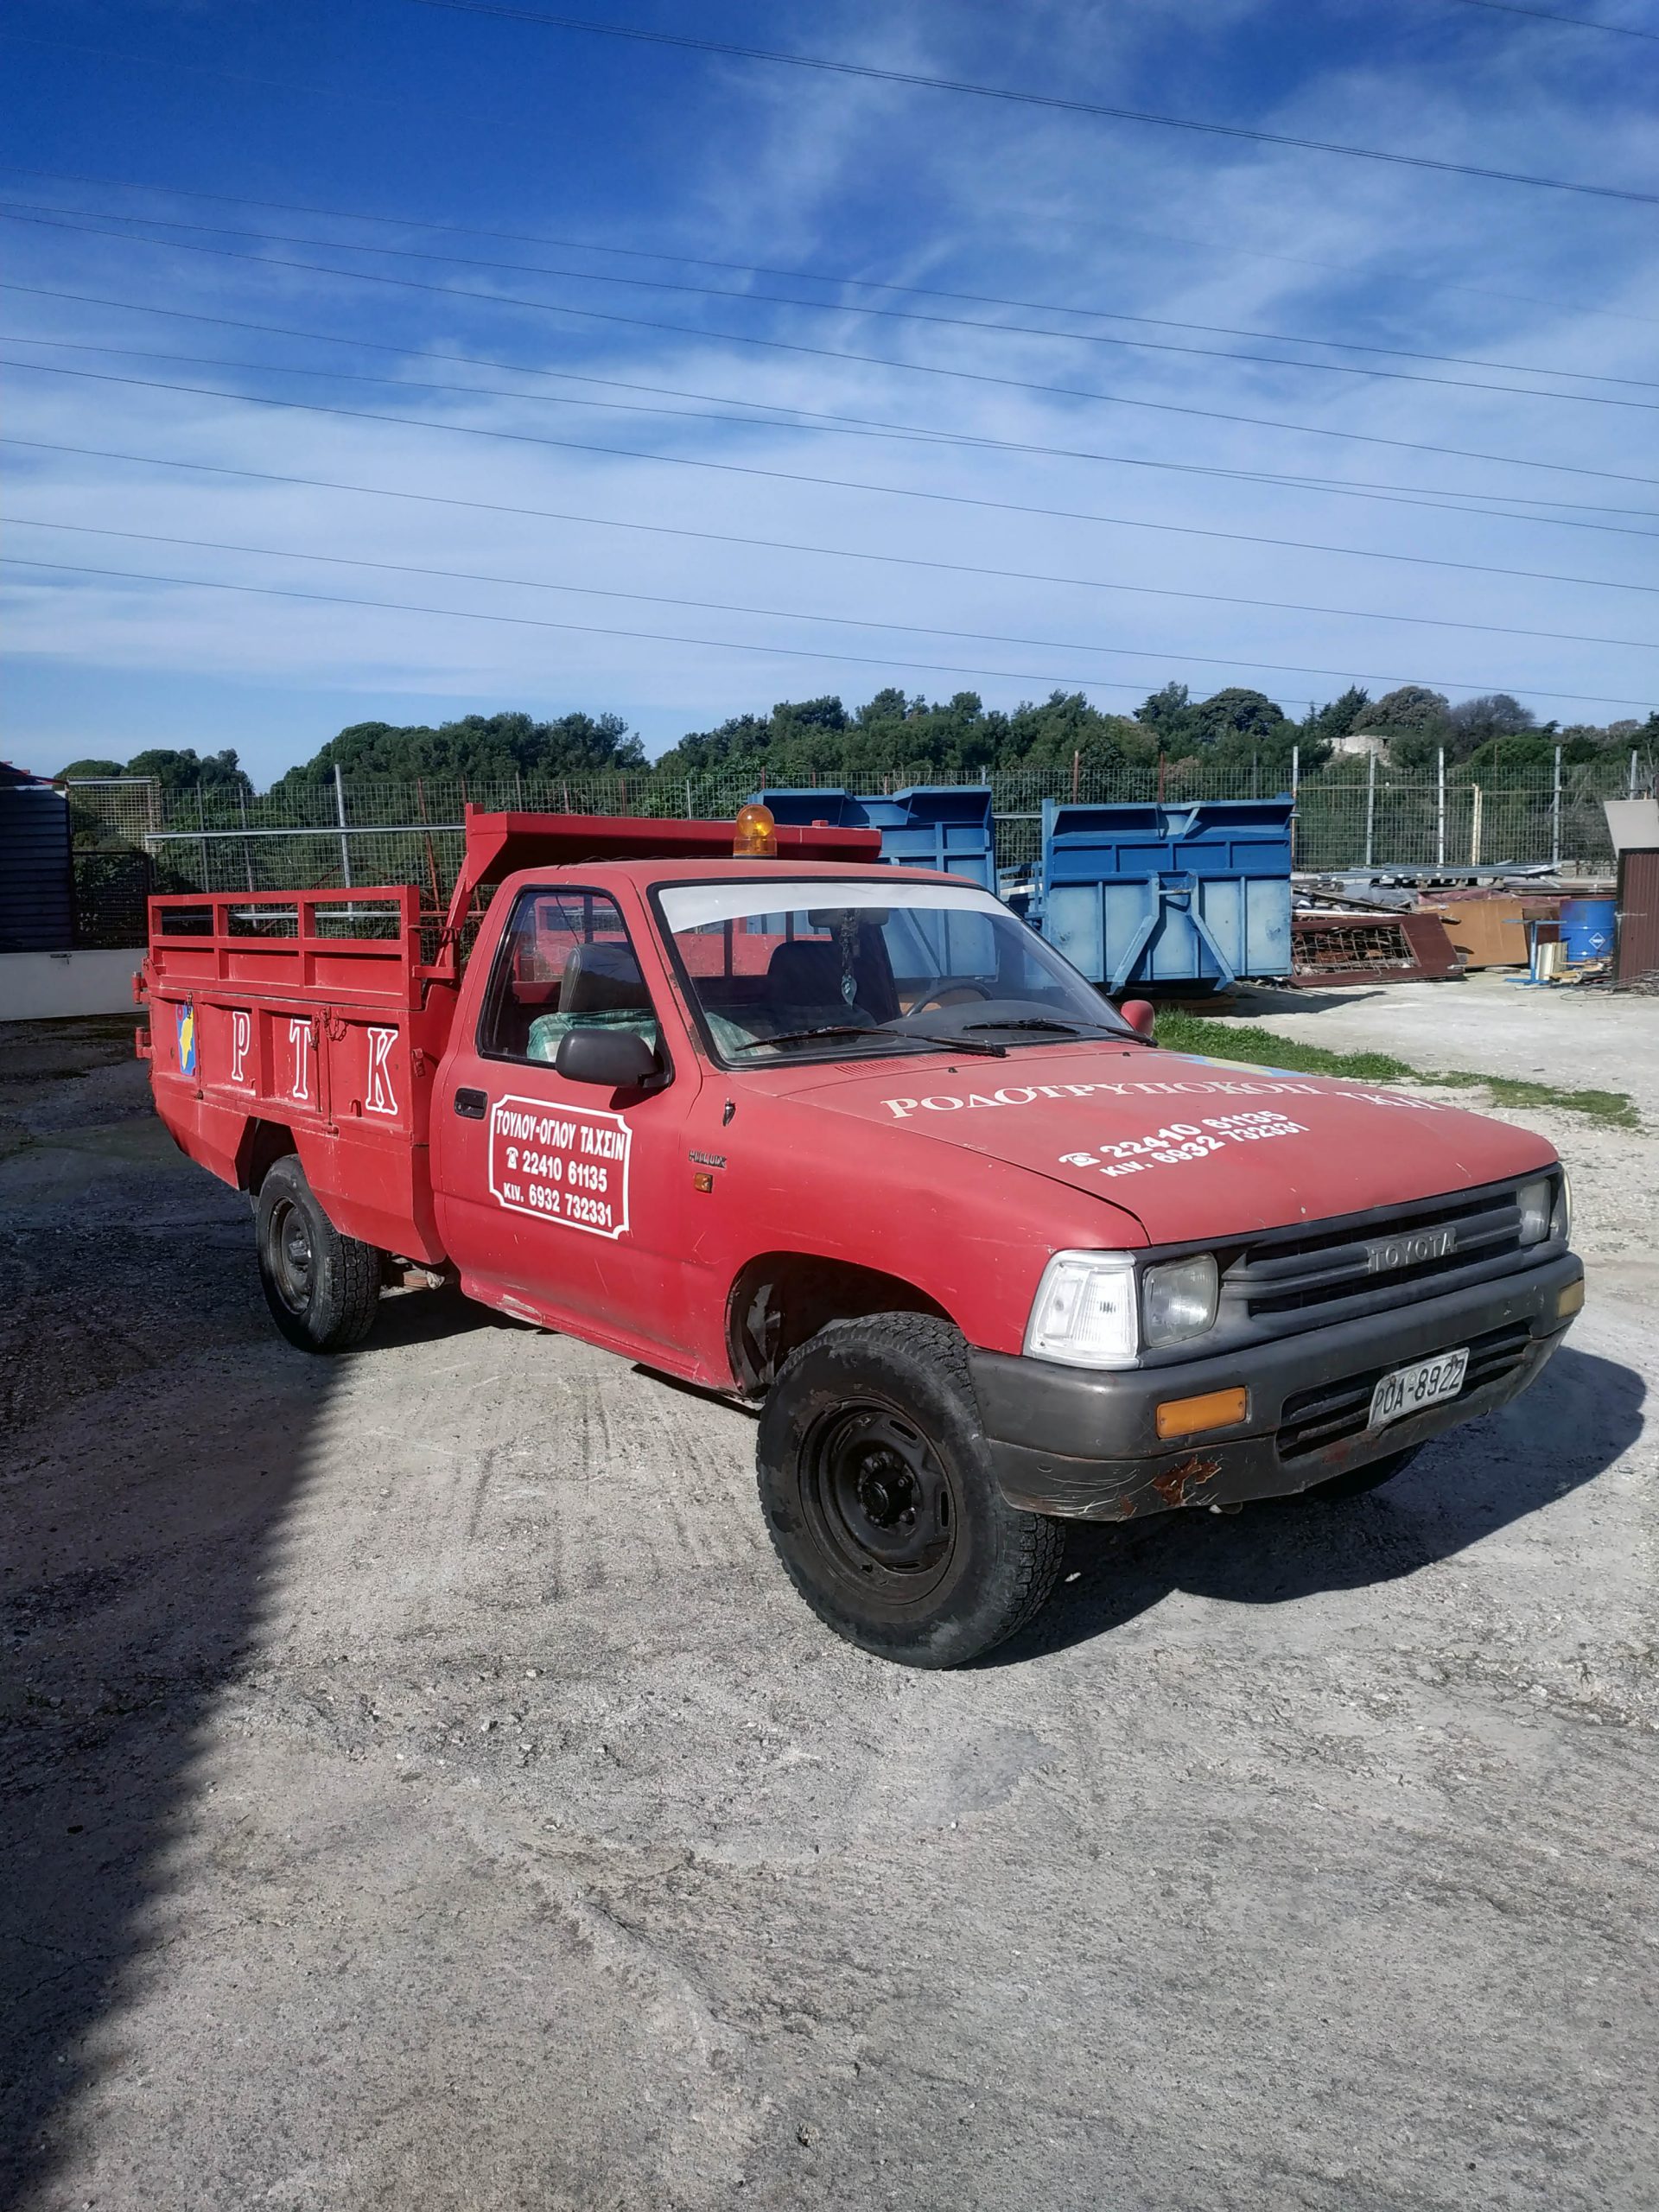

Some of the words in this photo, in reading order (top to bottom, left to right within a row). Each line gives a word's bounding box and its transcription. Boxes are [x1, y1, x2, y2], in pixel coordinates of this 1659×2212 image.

[496, 1109, 576, 1150] ΤΟΥΛΟΥ-ΟΓΛΟΥ
[581, 1126, 626, 1161] ΤΑΧΣΙΝ
[1099, 1123, 1202, 1158] 22410
[1202, 1110, 1288, 1129] 61135
[1150, 1135, 1226, 1164] 6932
[1217, 1122, 1311, 1142] 732331
[523, 1150, 562, 1181] 22410
[568, 1160, 607, 1192] 61135
[689, 1150, 727, 1168] HILUX
[529, 1184, 560, 1212] 6932
[565, 1193, 612, 1227] 732331
[1370, 1232, 1456, 1271] TOYOTA
